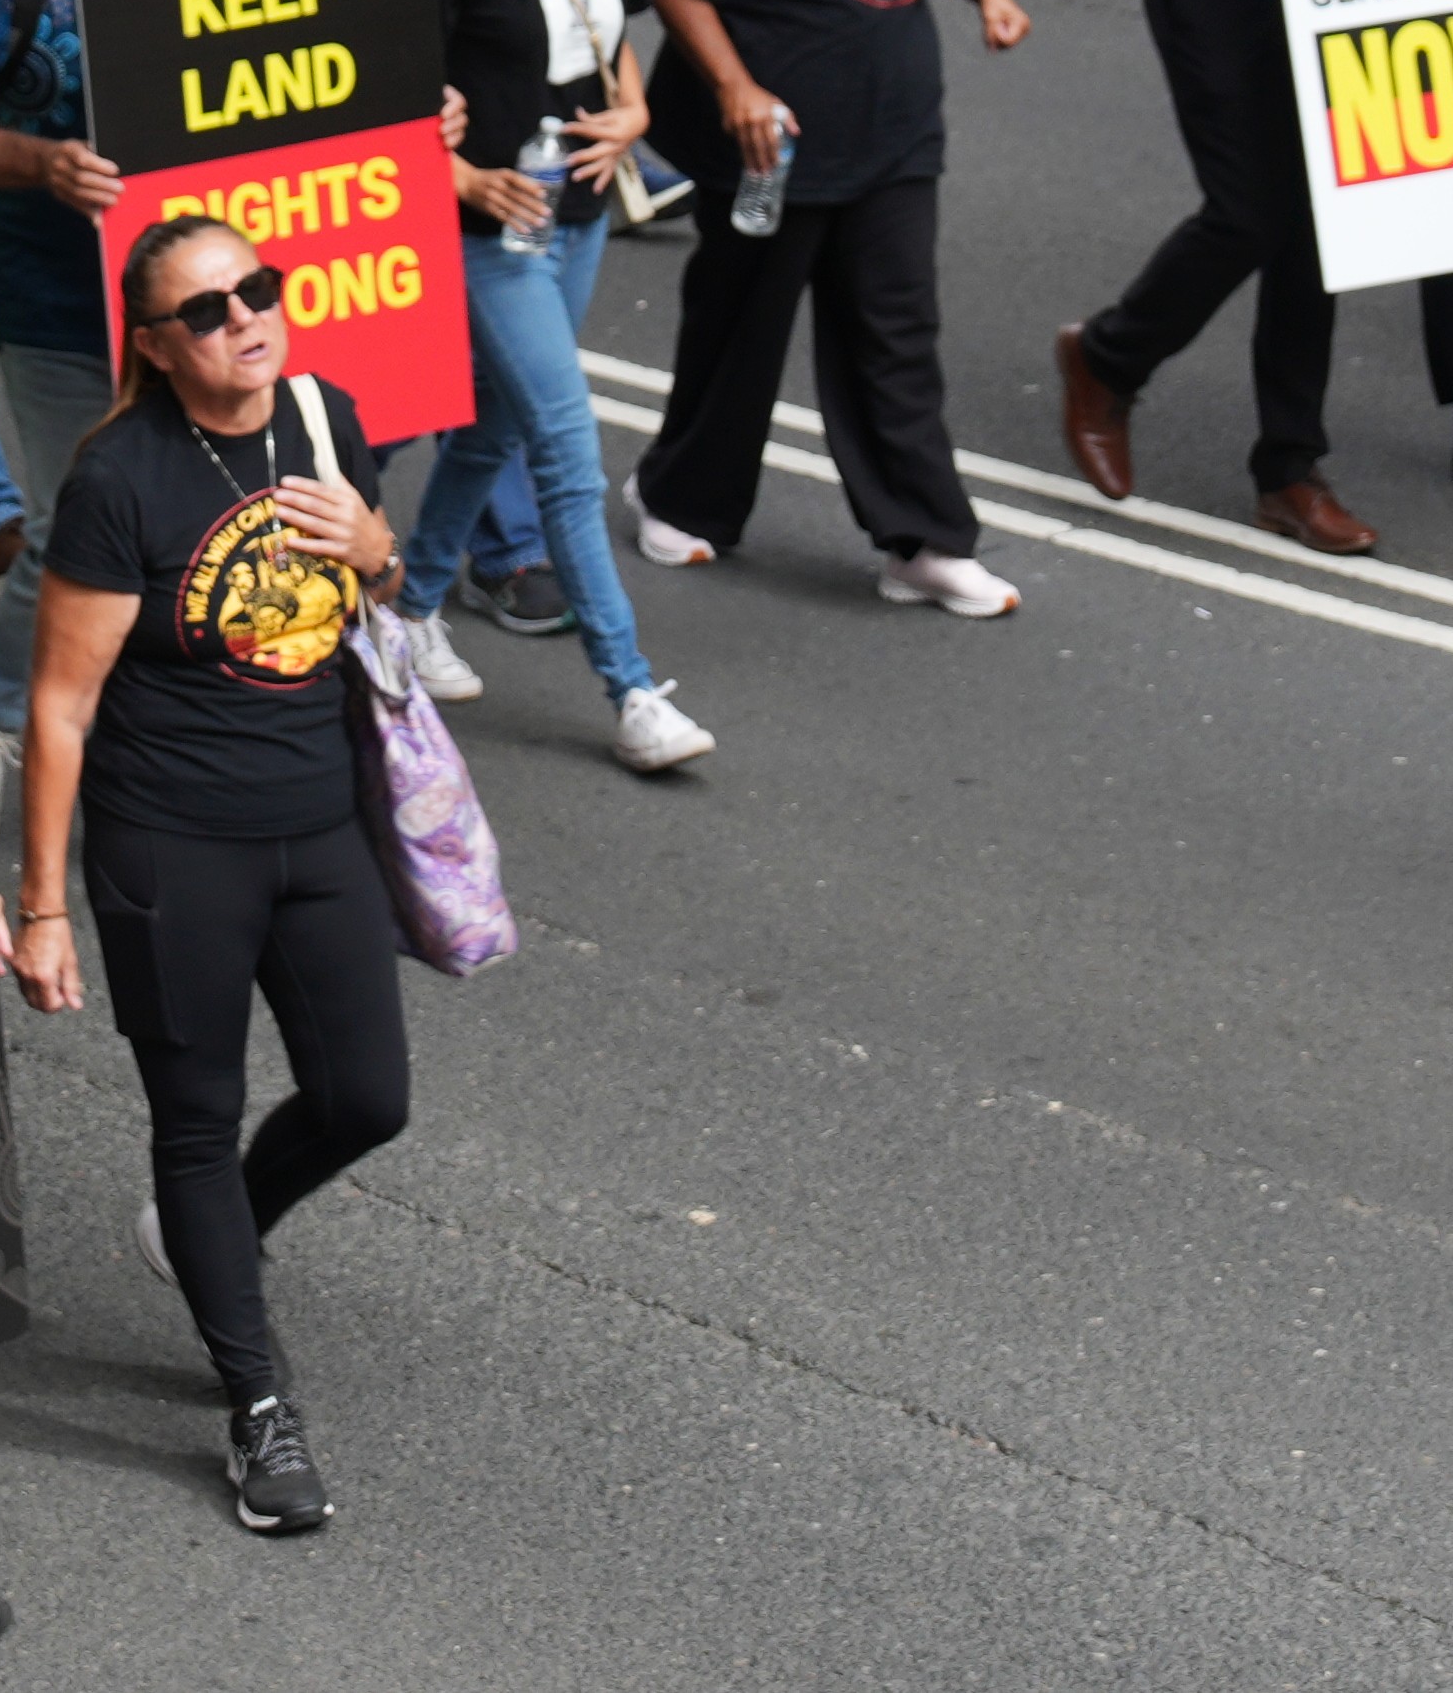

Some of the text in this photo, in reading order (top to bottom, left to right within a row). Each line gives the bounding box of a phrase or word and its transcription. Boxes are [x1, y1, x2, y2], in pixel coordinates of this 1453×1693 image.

[182, 42, 356, 133] LAND
[285, 244, 423, 329] ONG
[184, 589, 210, 623] WE
[201, 520, 245, 567] WALK
